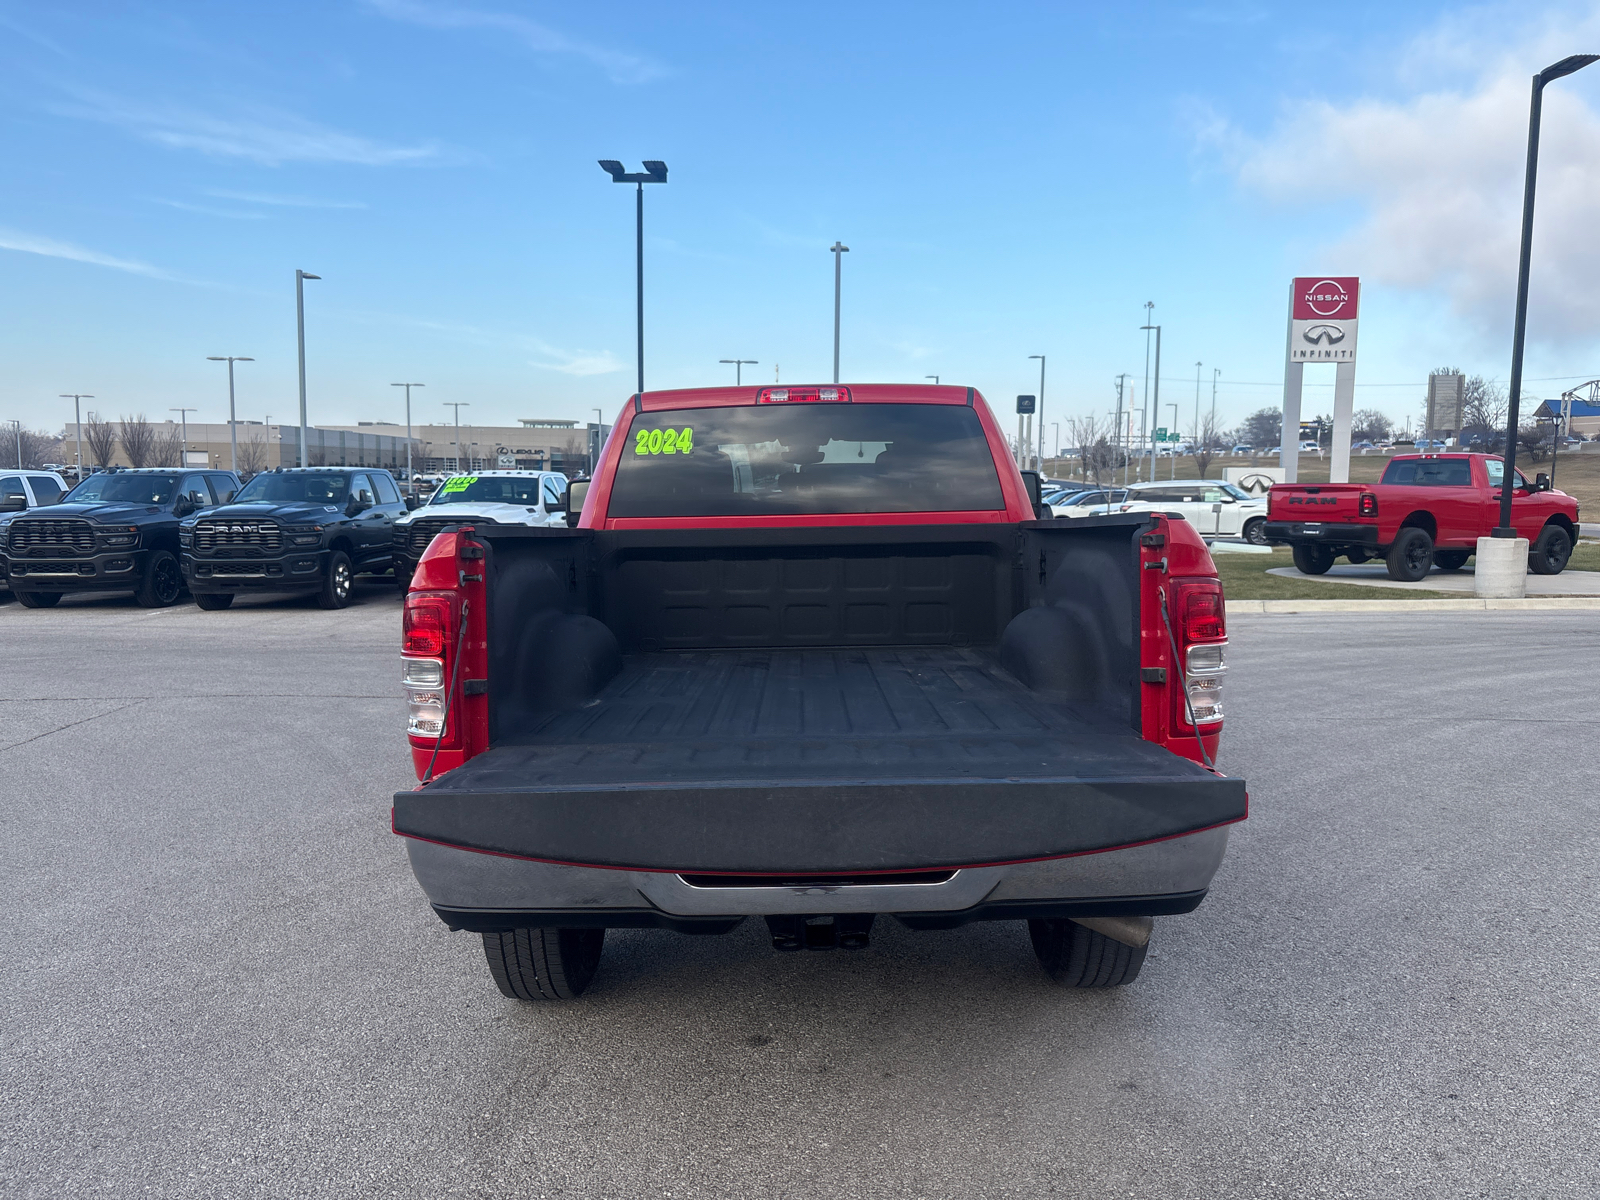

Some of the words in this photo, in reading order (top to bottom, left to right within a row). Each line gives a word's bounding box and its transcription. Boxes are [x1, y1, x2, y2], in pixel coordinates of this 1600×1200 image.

[1293, 350, 1353, 358] INFINITI
[635, 427, 693, 455] 2024
[1288, 497, 1337, 505] RAM
